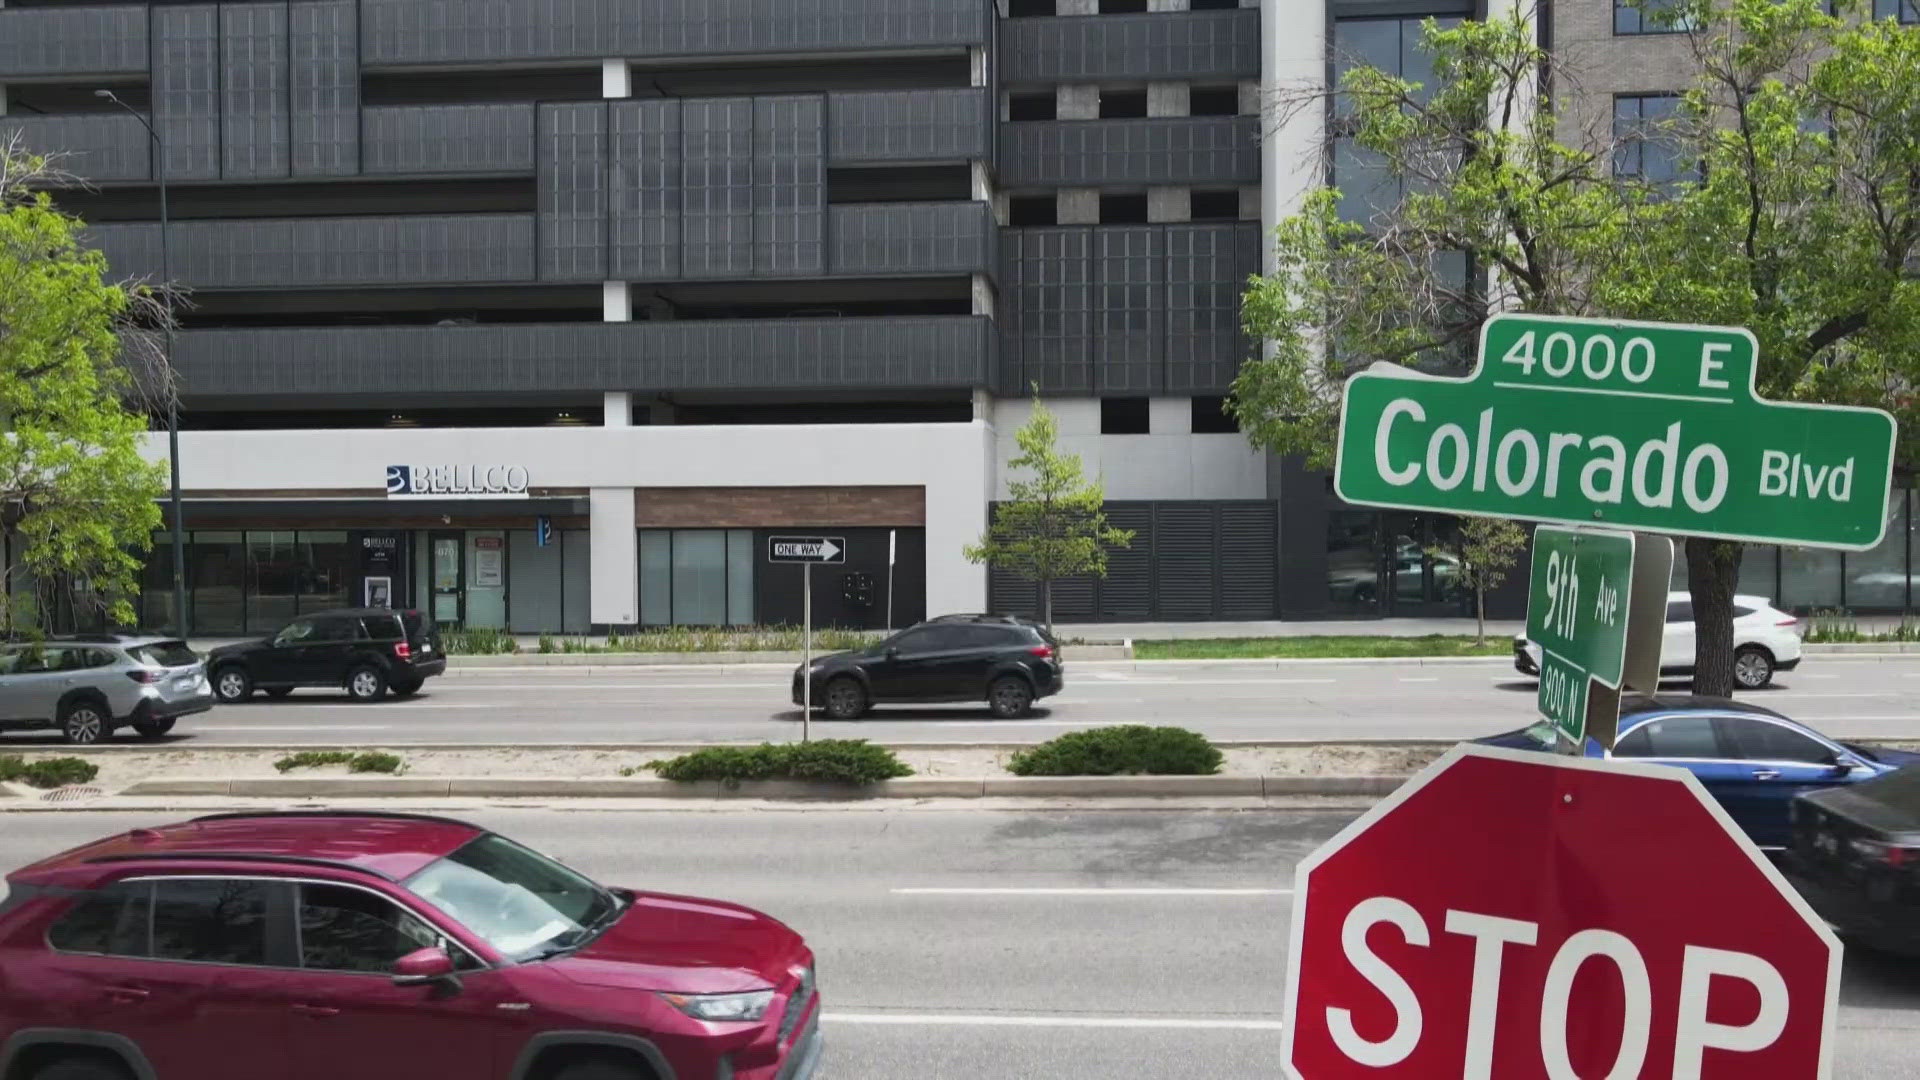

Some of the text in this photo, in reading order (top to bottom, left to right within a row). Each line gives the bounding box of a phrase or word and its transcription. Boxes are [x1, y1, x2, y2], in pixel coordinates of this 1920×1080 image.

[1502, 330, 1733, 389] 4000 E
[409, 463, 529, 493] BELLCO
[1374, 397, 1855, 514] Colorado Blvd
[777, 543, 822, 556] ONE WAY
[1544, 550, 1618, 641] 9th Ave
[1545, 664, 1580, 727] 900 N
[1325, 896, 1790, 1080] STOP
